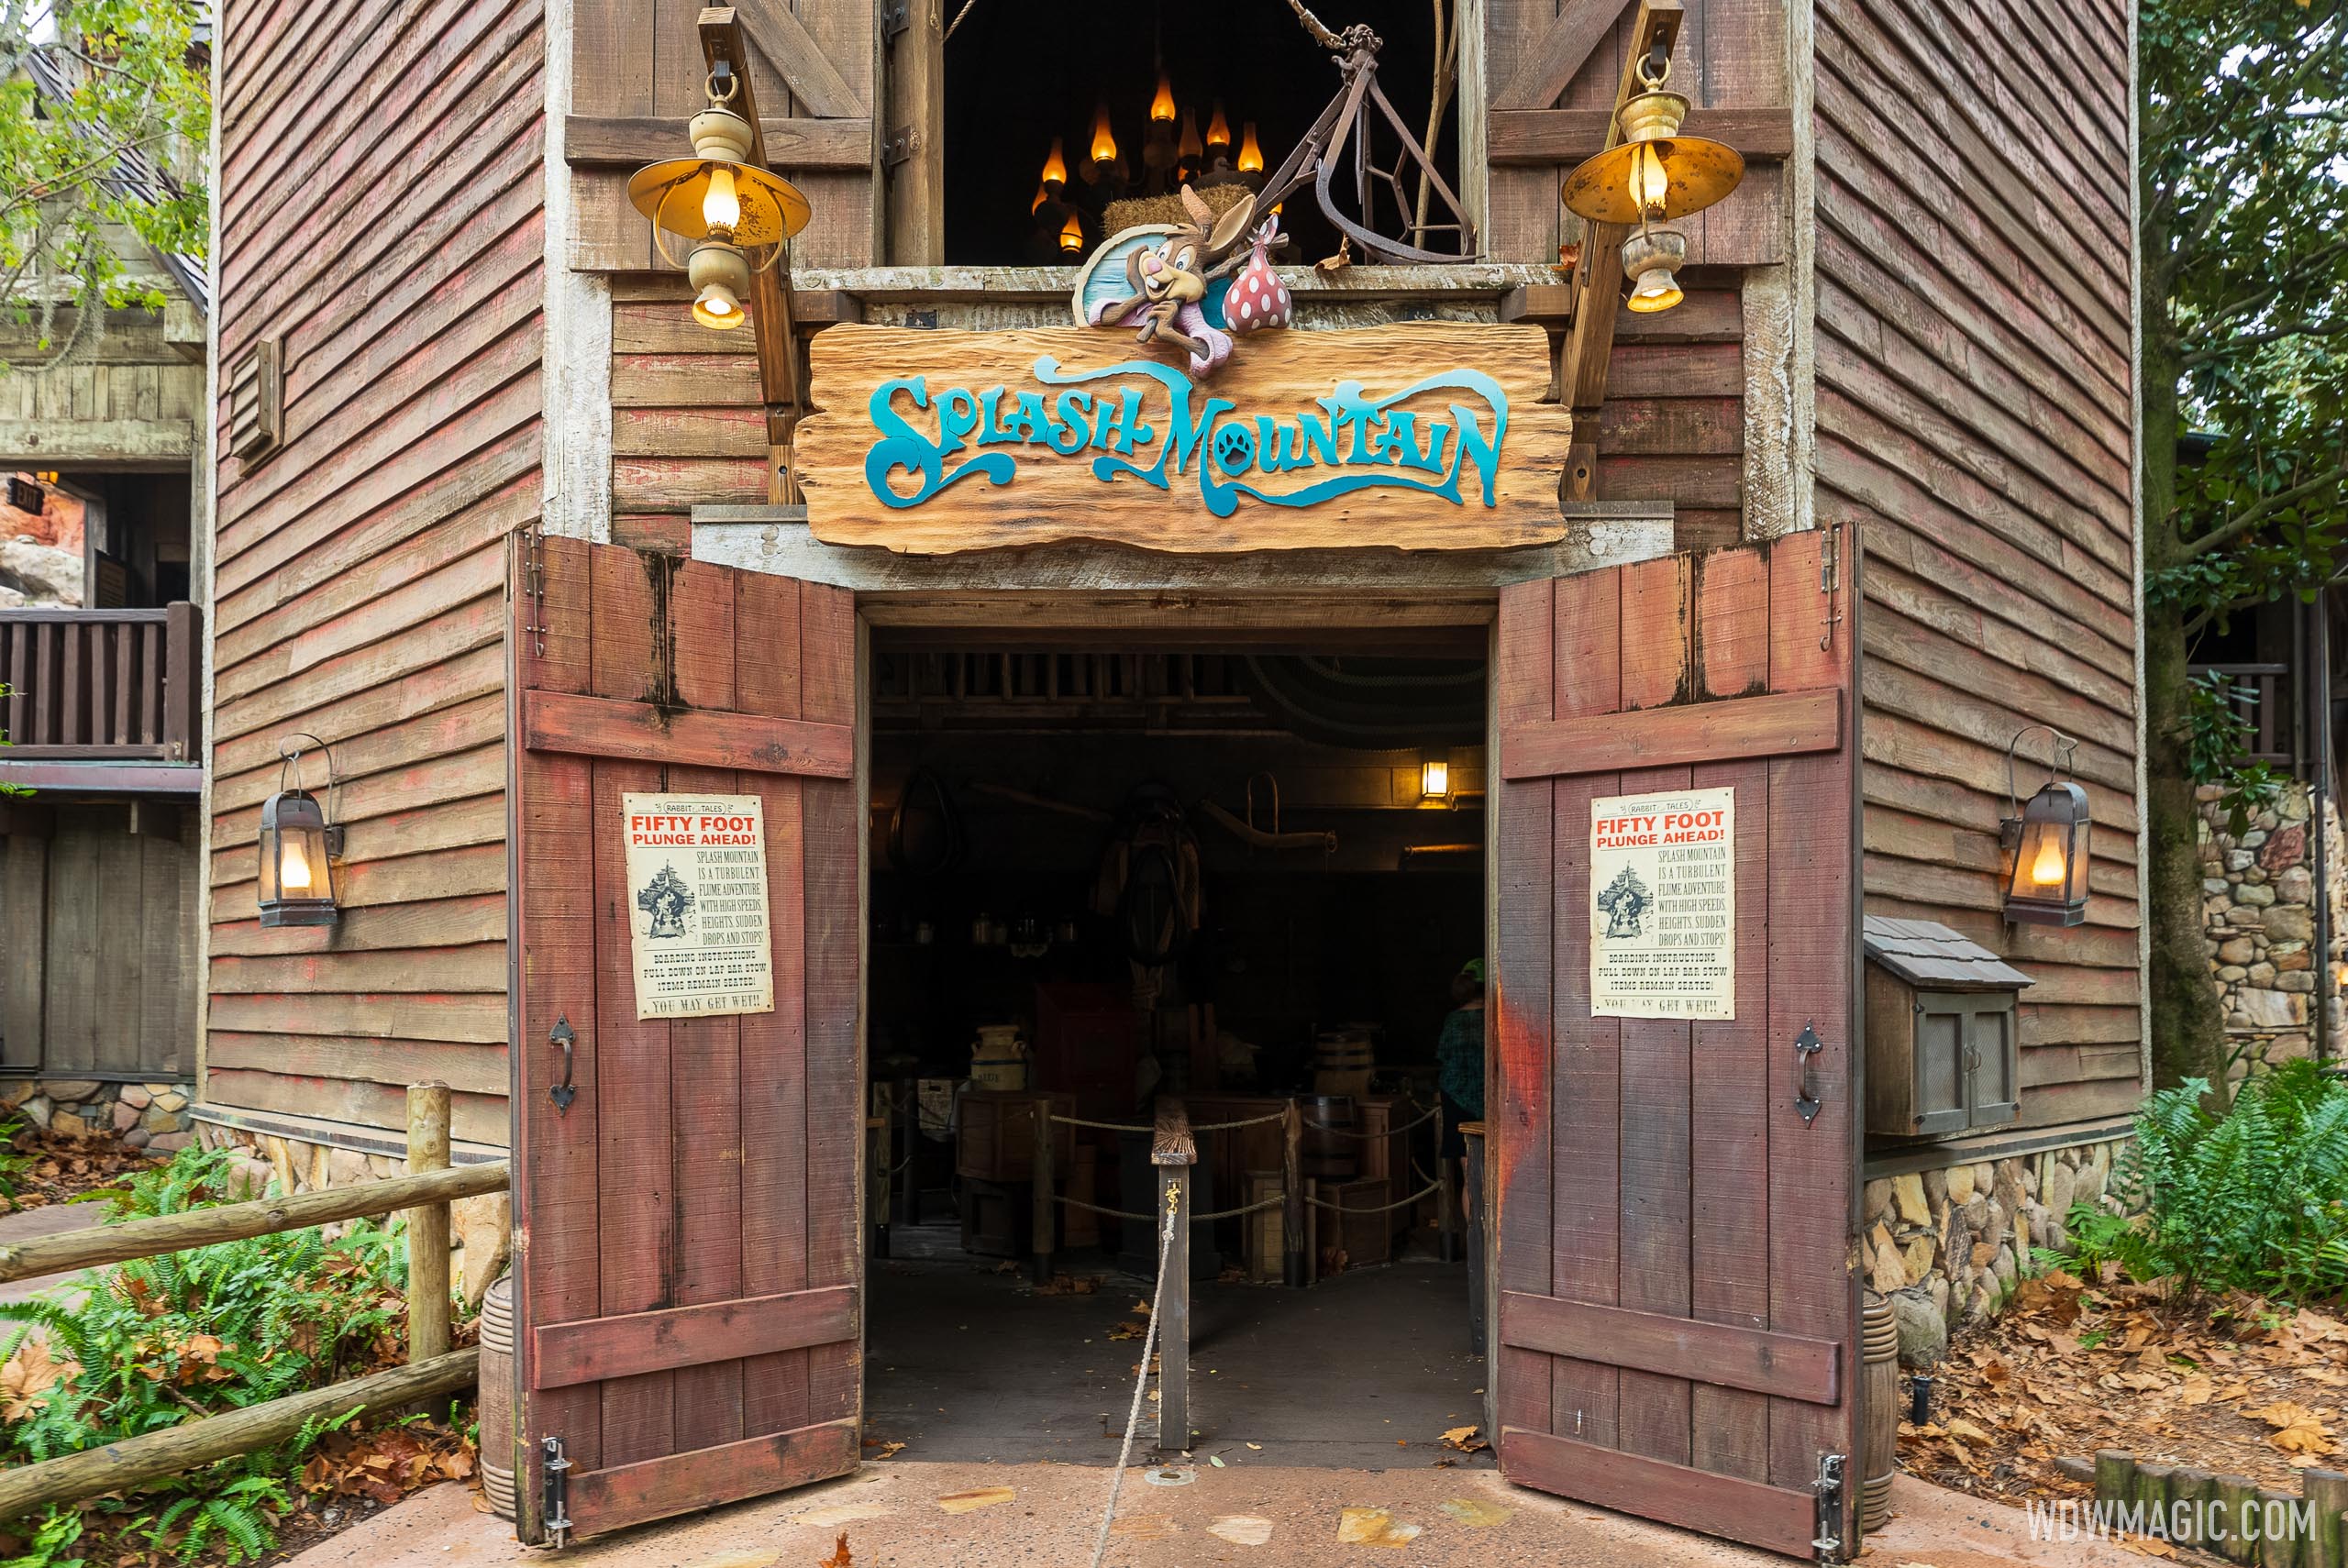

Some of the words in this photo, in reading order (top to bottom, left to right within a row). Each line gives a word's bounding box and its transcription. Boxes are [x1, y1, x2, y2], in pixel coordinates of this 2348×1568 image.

[17, 483, 38, 511] EXIT
[666, 803, 692, 812] RABBIT
[702, 804, 723, 812] TALES
[1631, 804, 1656, 812] RABBIT
[1666, 801, 1689, 811] TALES
[631, 815, 692, 831] FIFTY
[700, 816, 755, 832] FOOT
[1597, 815, 1657, 834] FIFTY
[1665, 811, 1724, 830] FOOT
[633, 834, 695, 845] PLUNGE
[701, 834, 757, 845] AHEAD!
[1597, 834, 1658, 848] PLUNGE
[1663, 829, 1724, 844] AHEAD!
[696, 851, 723, 864] SPLASH
[724, 851, 759, 864] MOUNTAIN
[1658, 848, 1686, 863] SPLASH
[1687, 846, 1726, 862] MOUNTAIN
[698, 867, 706, 880] IS
[708, 867, 714, 879] A
[714, 867, 760, 879] TURBULENT
[1658, 867, 1667, 880] IS
[1668, 867, 1674, 879] A
[1677, 864, 1726, 879] TURBULENT
[698, 883, 722, 897] FLUME
[723, 882, 761, 896] ADVENTURE
[1658, 883, 1682, 897] FLUME
[1683, 880, 1726, 896] ADVENTURE
[699, 900, 719, 912] WITH
[719, 900, 737, 912] HIGH
[1658, 900, 1678, 913] WITH
[1678, 899, 1697, 912] HIGH
[736, 914, 763, 928] SUDDEN
[1695, 915, 1726, 929] SUDDEN
[703, 932, 725, 945] DROPS
[726, 932, 740, 944] AND
[741, 931, 764, 944] STOPS!
[1658, 933, 1682, 946] DROPS
[1683, 933, 1700, 946] AND
[1700, 933, 1726, 945] STOPS!
[654, 953, 695, 964] BOARDING
[698, 950, 757, 962] INSTRUCTIONS
[1609, 954, 1650, 963] BOARDING
[1652, 953, 1716, 963] INSTRUCTIONS
[644, 968, 665, 978] PULL
[668, 966, 692, 977] DOWN
[695, 966, 706, 976] ON
[709, 965, 725, 975] LAP
[727, 964, 743, 974] BAR
[745, 963, 767, 973] STOW
[1599, 967, 1619, 977] PULL
[1622, 967, 1646, 977] DOWN
[1649, 967, 1660, 977] ON
[1663, 967, 1679, 977] LAP
[1683, 967, 1700, 977] BAR
[1702, 966, 1728, 977] STOW
[658, 981, 684, 991] ITEMS
[687, 978, 721, 989] REMAIN
[724, 977, 756, 988] SEATED!
[1611, 981, 1636, 990] ITEMS
[1639, 981, 1674, 990] REMAIN
[1678, 981, 1713, 990] SEATED!
[652, 999, 676, 1013] YOU
[680, 998, 702, 1011] MAY
[707, 996, 727, 1010] GET
[732, 995, 760, 1008] WET!!
[1659, 999, 1680, 1012] GET
[1686, 999, 1717, 1012] WET!!
